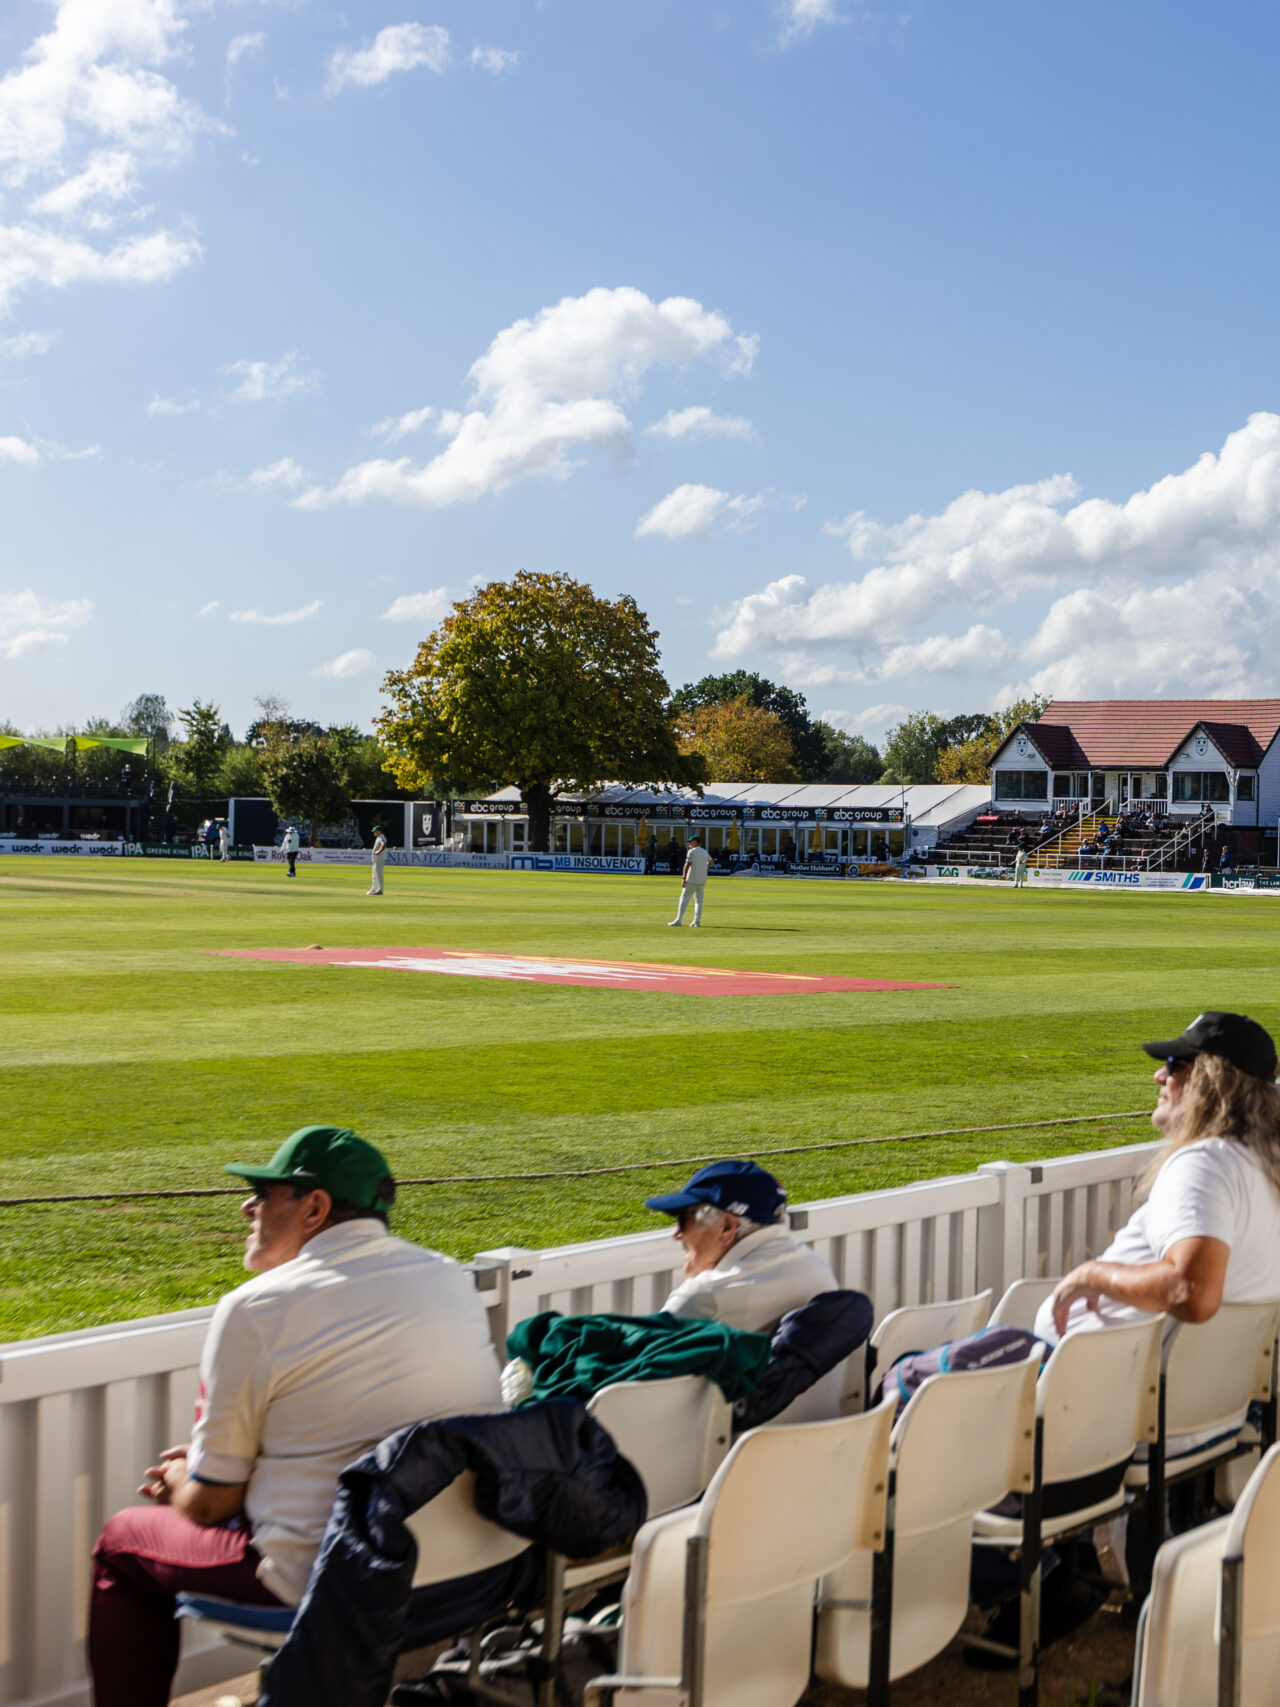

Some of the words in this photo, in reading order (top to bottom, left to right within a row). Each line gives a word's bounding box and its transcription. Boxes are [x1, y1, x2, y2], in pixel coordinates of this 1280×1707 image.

[471, 802, 489, 813] ebc
[489, 803, 515, 814] group
[556, 804, 582, 814] group
[605, 805, 624, 816] ebc
[625, 808, 651, 817] group
[690, 807, 709, 818] ebc
[710, 808, 737, 819] group
[762, 808, 781, 819] ebc
[781, 810, 810, 820] group
[834, 809, 854, 820] ebc
[855, 810, 883, 821] group
[125, 842, 144, 857] IPA
[191, 844, 210, 859] IPA
[387, 852, 410, 865] NJA
[411, 852, 451, 865] POTZE
[555, 857, 572, 867] MB
[574, 857, 642, 869] INSOLVENCY
[790, 864, 810, 872] Mother
[810, 864, 840, 872] Hubbard's
[1094, 871, 1141, 884] SMITHS
